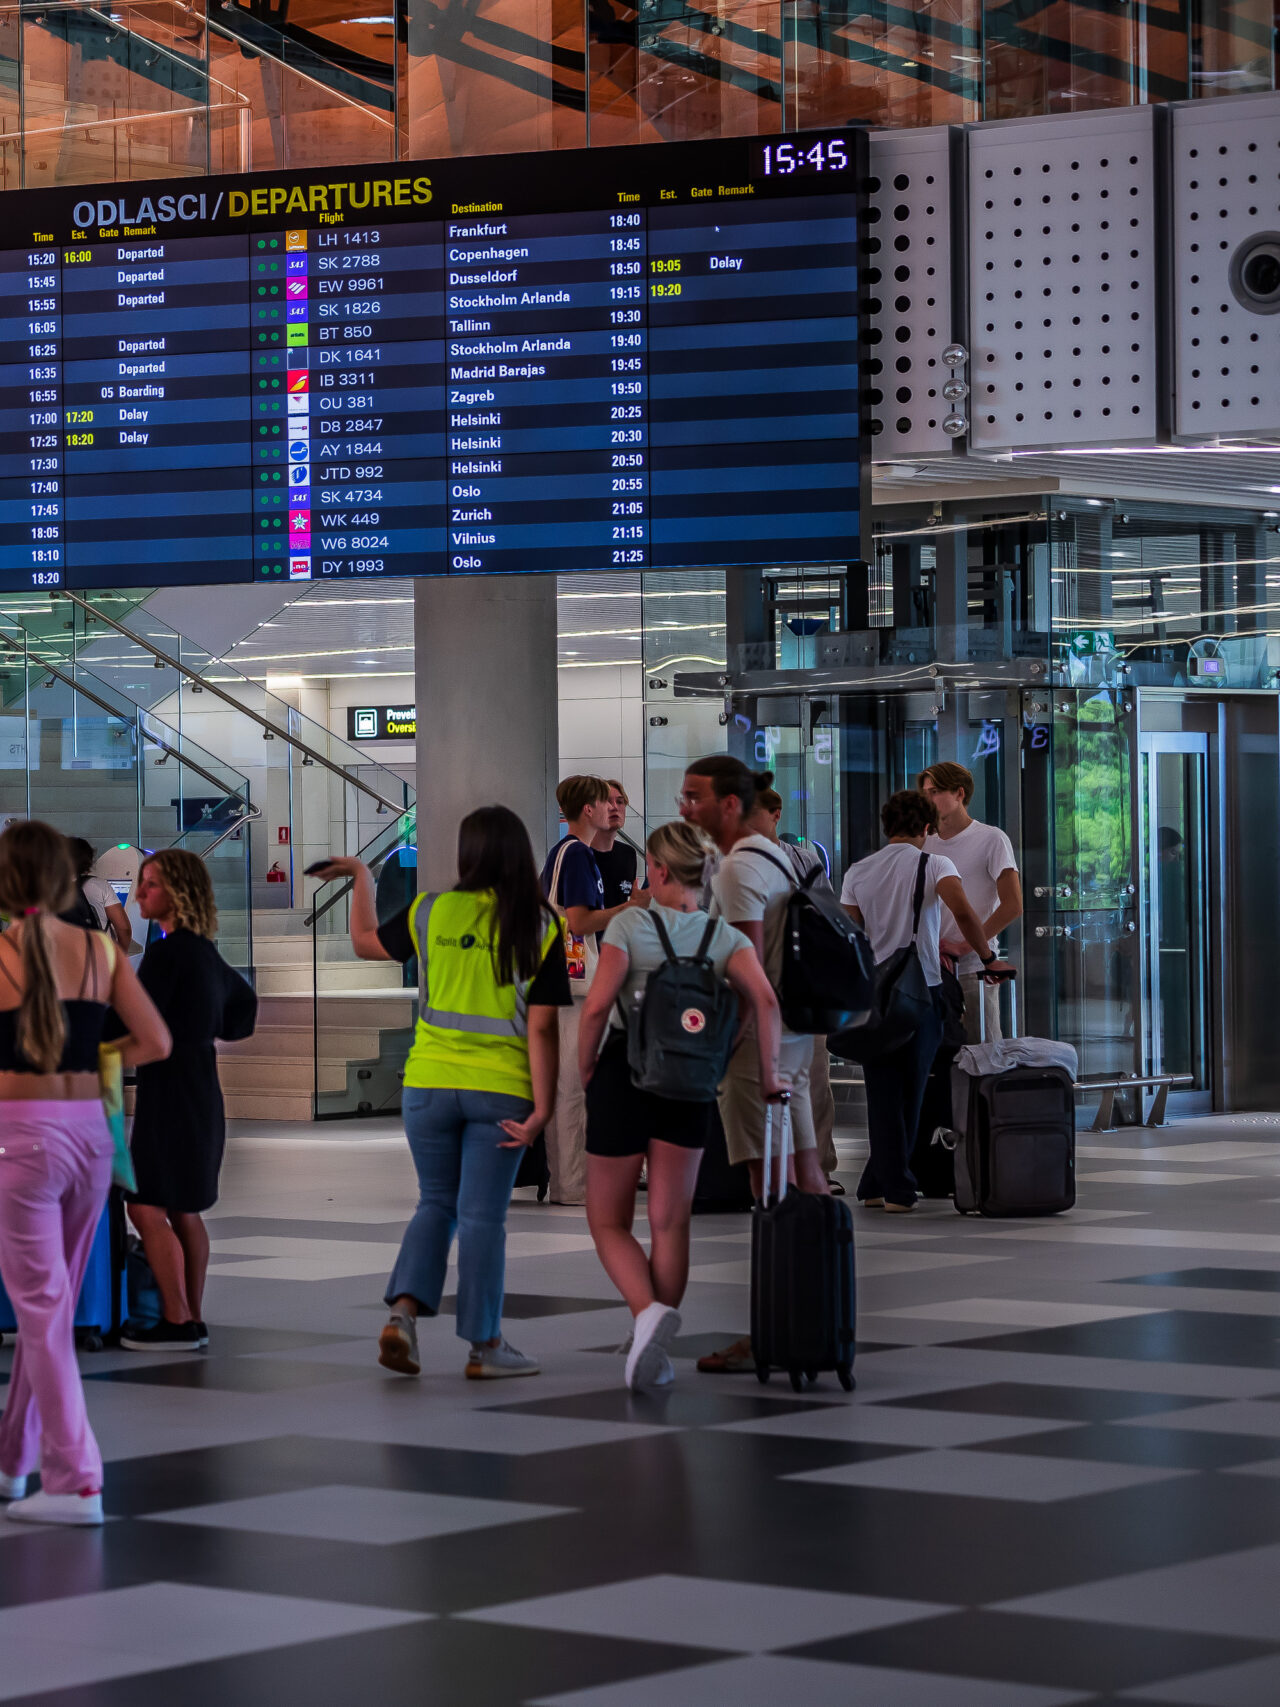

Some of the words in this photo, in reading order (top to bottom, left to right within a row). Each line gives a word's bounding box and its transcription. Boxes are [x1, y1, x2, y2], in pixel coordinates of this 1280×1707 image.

[763, 140, 847, 175] 15:45
[451, 201, 503, 214] Destination
[616, 192, 641, 203] Time
[660, 189, 678, 200] Est.
[690, 187, 713, 198] Gate
[718, 183, 754, 196] Remark
[319, 212, 344, 226] Flight
[32, 232, 54, 243] Time
[71, 229, 88, 240] Est.
[99, 227, 119, 238] Gate
[123, 224, 157, 236] Remark
[27, 252, 55, 266] 15:20
[64, 250, 92, 264] 16:00
[117, 245, 164, 262] Departed
[318, 256, 339, 270] SK
[342, 254, 380, 268] 2788
[449, 247, 529, 263] Copenhagen
[609, 238, 640, 252] 18:45
[318, 279, 344, 293] EW
[348, 277, 383, 291] 9961
[449, 269, 518, 285] Dusseldorf
[610, 261, 641, 276] 18:50
[650, 259, 681, 273] 19:05
[710, 255, 743, 271] Delay
[28, 298, 56, 312] 15:55
[118, 291, 165, 308] Departed
[318, 303, 339, 317] SK
[344, 301, 381, 315] 1826
[449, 293, 518, 309] Stockholm
[520, 290, 570, 305] Arlanda
[610, 286, 641, 300] 19:15
[650, 283, 682, 297] 19:20
[29, 344, 57, 357] 16:25
[118, 337, 165, 354] Departed
[319, 350, 341, 364] DK
[346, 348, 380, 362] 1641
[450, 341, 518, 356] Stockholm
[521, 338, 571, 352] Arlanda
[610, 333, 642, 347] 19:40
[29, 389, 57, 403] 16:55
[101, 386, 114, 399] 05
[119, 384, 165, 398] Boarding
[319, 397, 342, 410] OU
[347, 395, 373, 409] 381
[450, 389, 495, 405] Zagreb
[611, 381, 642, 395] 19:50
[29, 412, 58, 425] 17:00
[65, 410, 94, 424] 17:20
[119, 408, 149, 422] Delay
[30, 435, 58, 448] 17:25
[65, 433, 94, 446] 18:20
[119, 430, 149, 445] Delay
[319, 443, 341, 457] AY
[345, 442, 383, 455] 1844
[451, 436, 501, 450] Helsinki
[611, 429, 642, 443] 20:30
[30, 481, 59, 494] 17:40
[321, 490, 341, 504] SK
[344, 489, 383, 502] 4734
[452, 485, 481, 498] Oslo
[611, 478, 643, 491] 20:55
[31, 503, 59, 517] 17:45
[320, 537, 347, 550] W6
[351, 536, 390, 549] 8024
[452, 532, 496, 545] Vilnius
[612, 526, 643, 539] 21:15
[31, 549, 60, 562] 18:10
[322, 560, 343, 574] DY
[347, 559, 384, 573] 1993
[452, 556, 482, 569] Oslo
[612, 550, 644, 563] 21:25
[32, 572, 60, 585] 18:20
